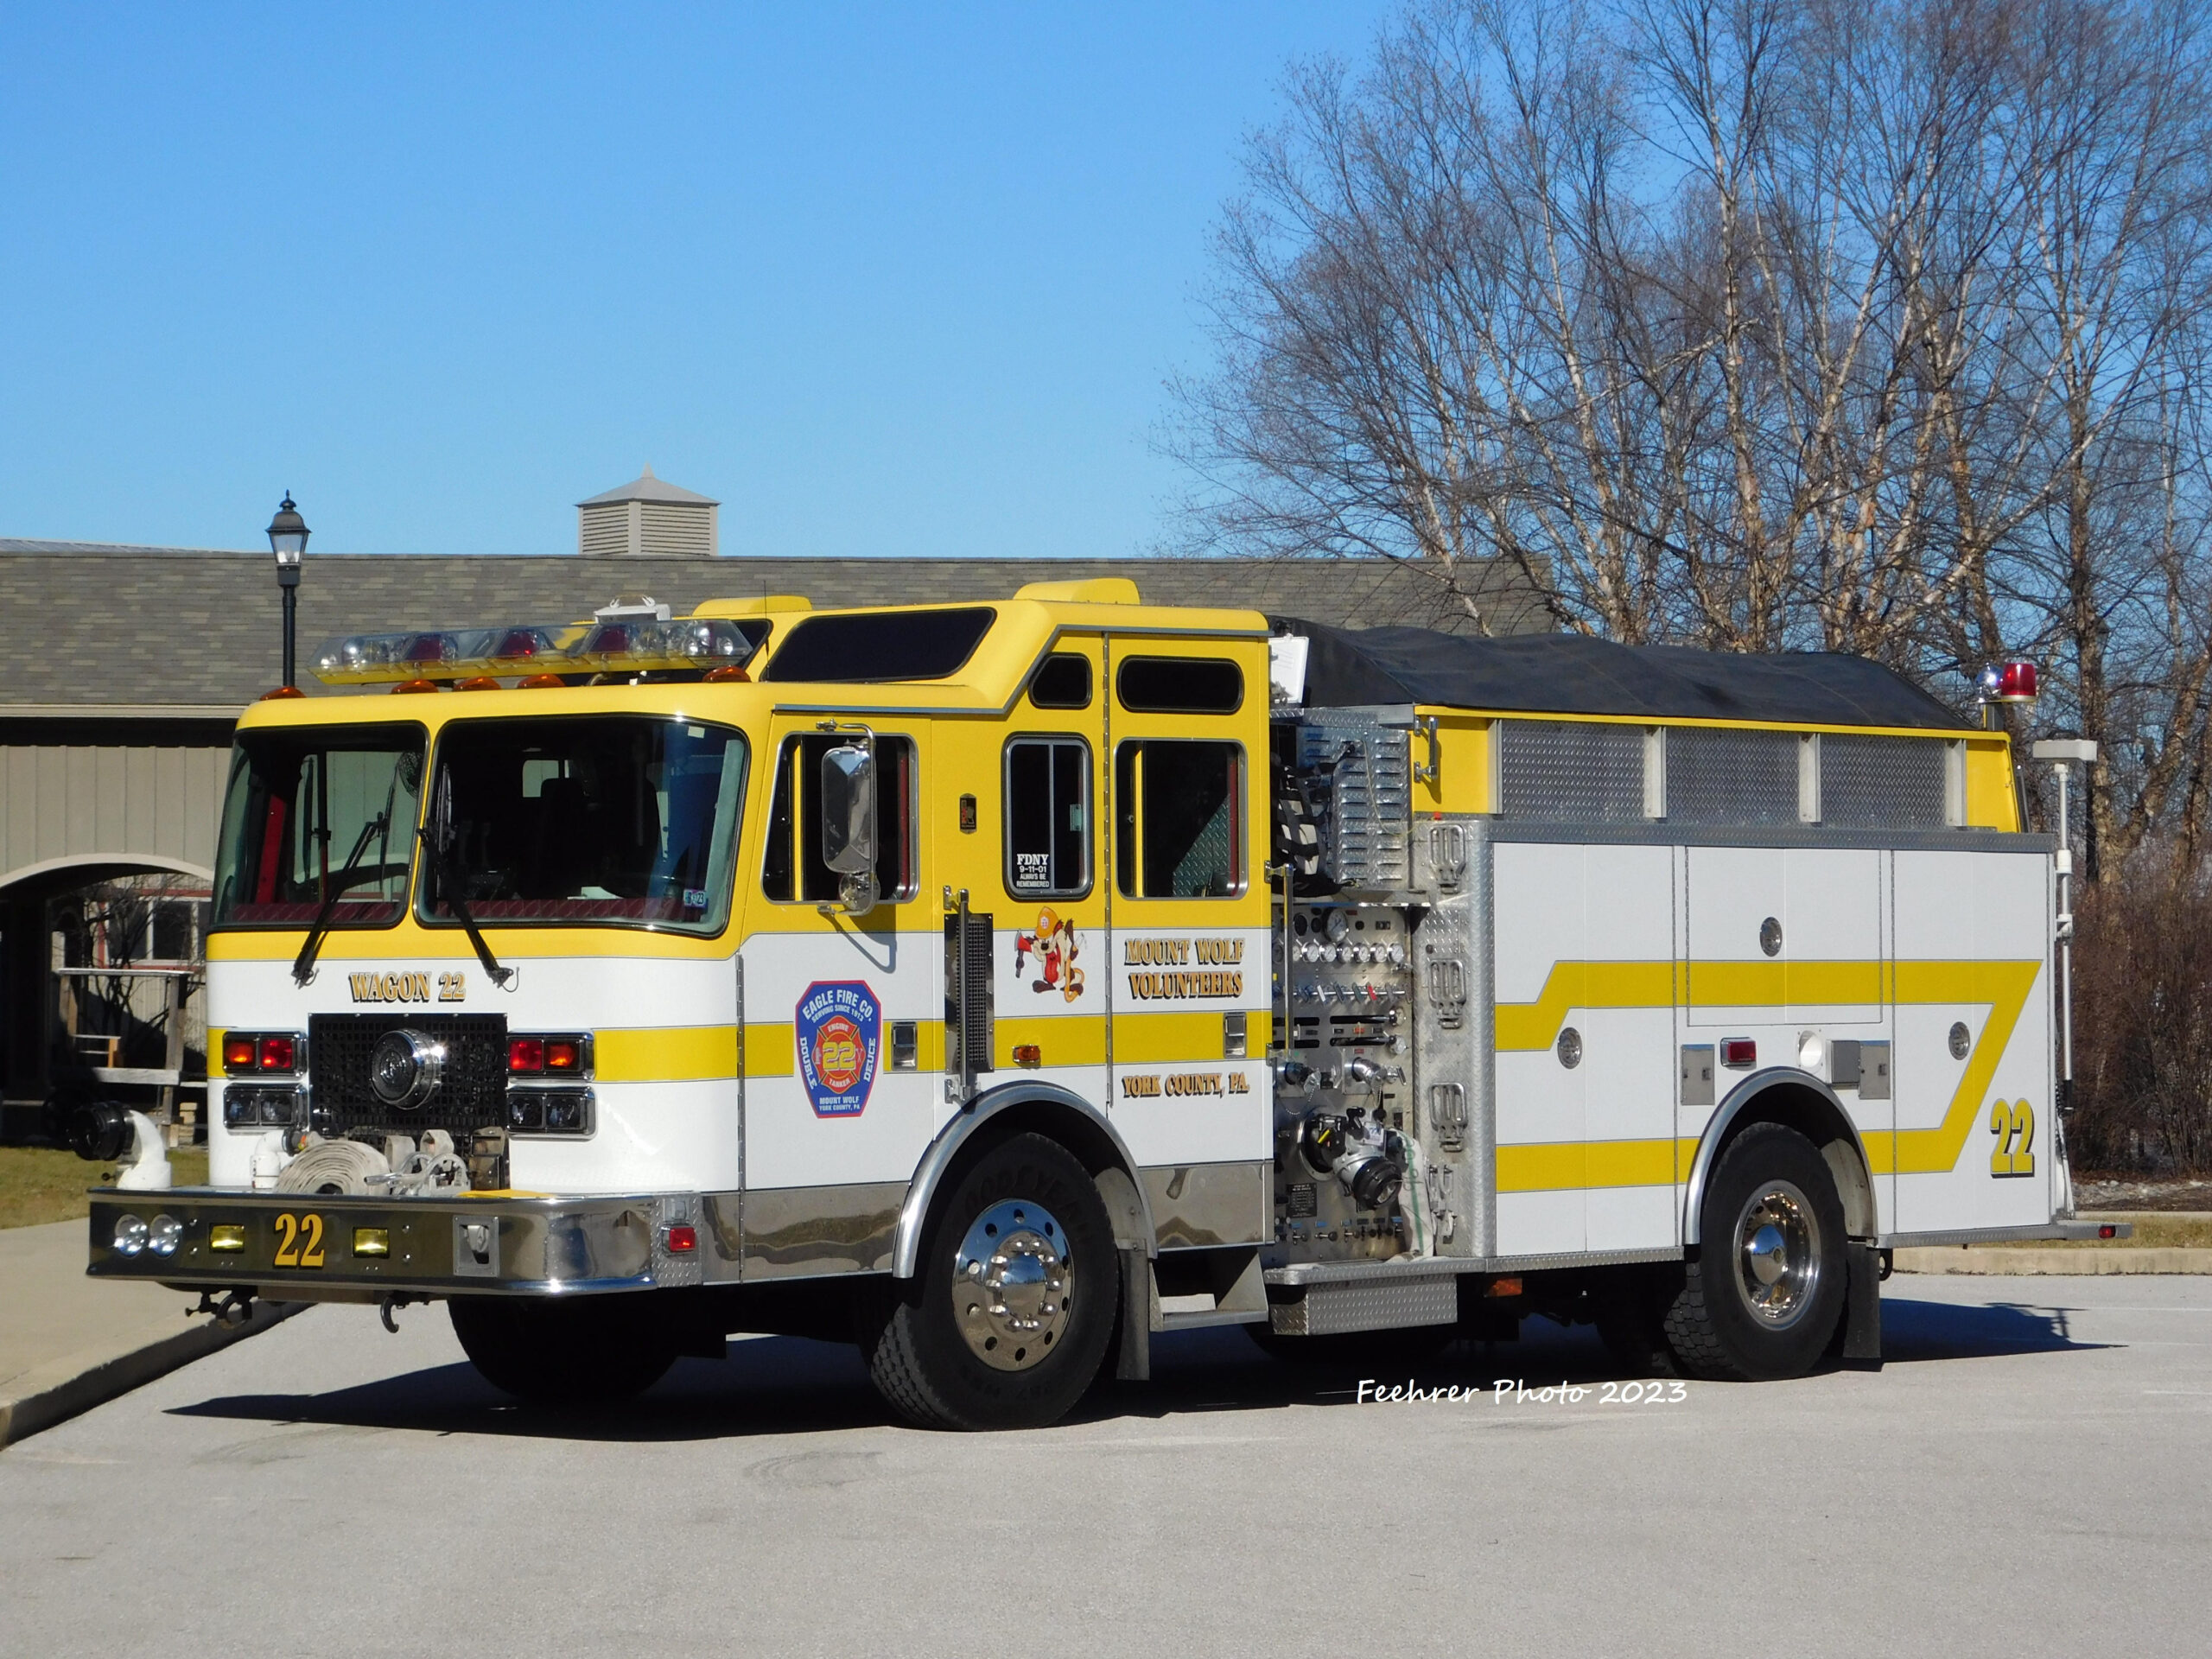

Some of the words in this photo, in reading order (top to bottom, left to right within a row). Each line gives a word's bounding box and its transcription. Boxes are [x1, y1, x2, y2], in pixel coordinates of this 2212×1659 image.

[1017, 854, 1049, 865] FDNY
[1124, 938, 1190, 965] MOUNT
[1195, 938, 1244, 965] WOLF
[348, 971, 432, 1002] WAGON
[438, 971, 465, 1002] 22
[1128, 971, 1243, 1000] VOLUNTEERS
[802, 990, 834, 1020] EAGLE
[836, 989, 859, 1007] FIRE
[859, 1000, 873, 1021] CO.
[811, 1005, 834, 1023] SERVING
[835, 1004, 850, 1014] SINCE
[800, 1037, 817, 1090] DOUBLE
[823, 1041, 856, 1071] 22
[863, 1038, 876, 1082] DEUCE
[830, 1078, 850, 1088] TANKER
[1122, 1075, 1161, 1098] YORK
[1165, 1073, 1224, 1098] COUNTY,
[843, 1096, 860, 1104] WOLF
[1991, 1098, 2035, 1179] 22
[273, 1212, 325, 1268] 22
